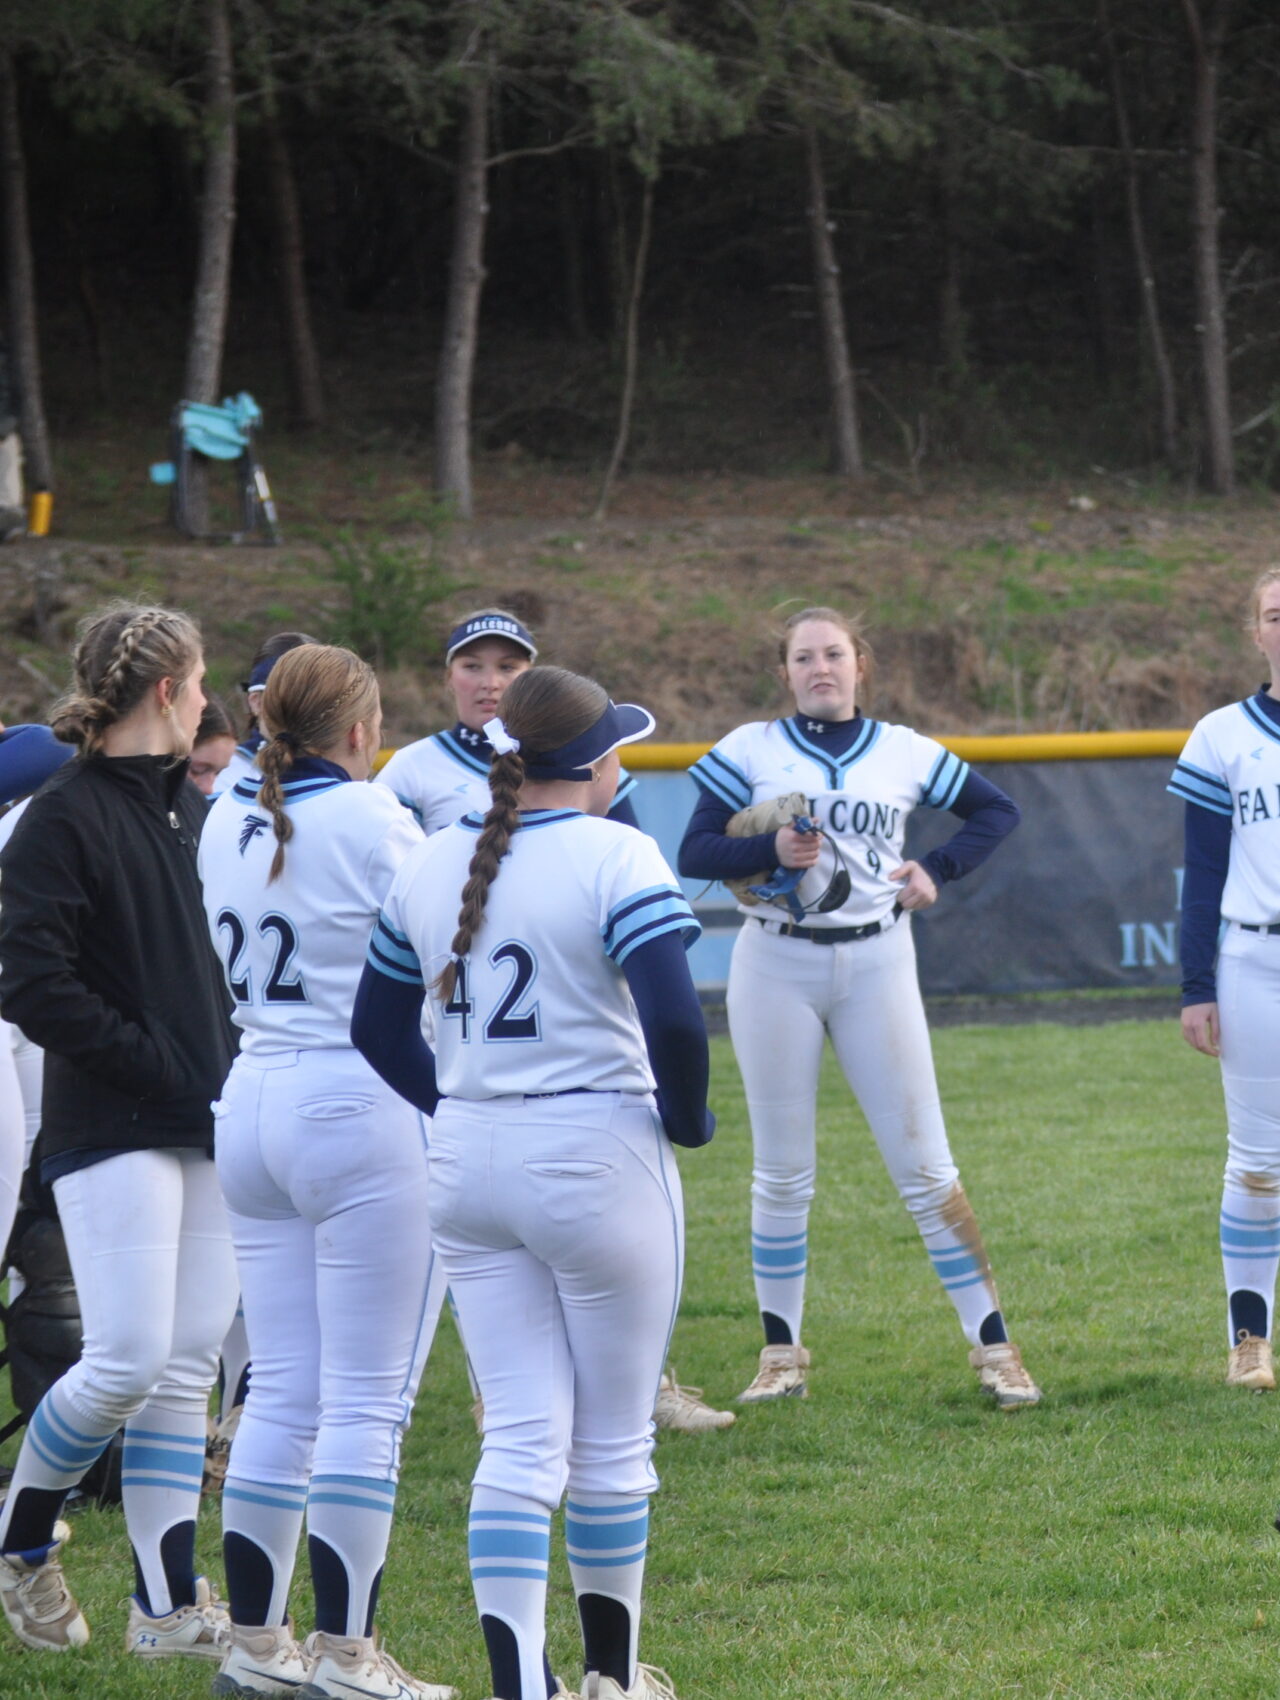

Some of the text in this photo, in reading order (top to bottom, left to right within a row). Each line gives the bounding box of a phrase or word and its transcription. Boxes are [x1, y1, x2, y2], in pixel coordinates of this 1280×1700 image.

[866, 848, 882, 878] 9
[216, 906, 312, 1006] 22
[441, 938, 542, 1044] 42
